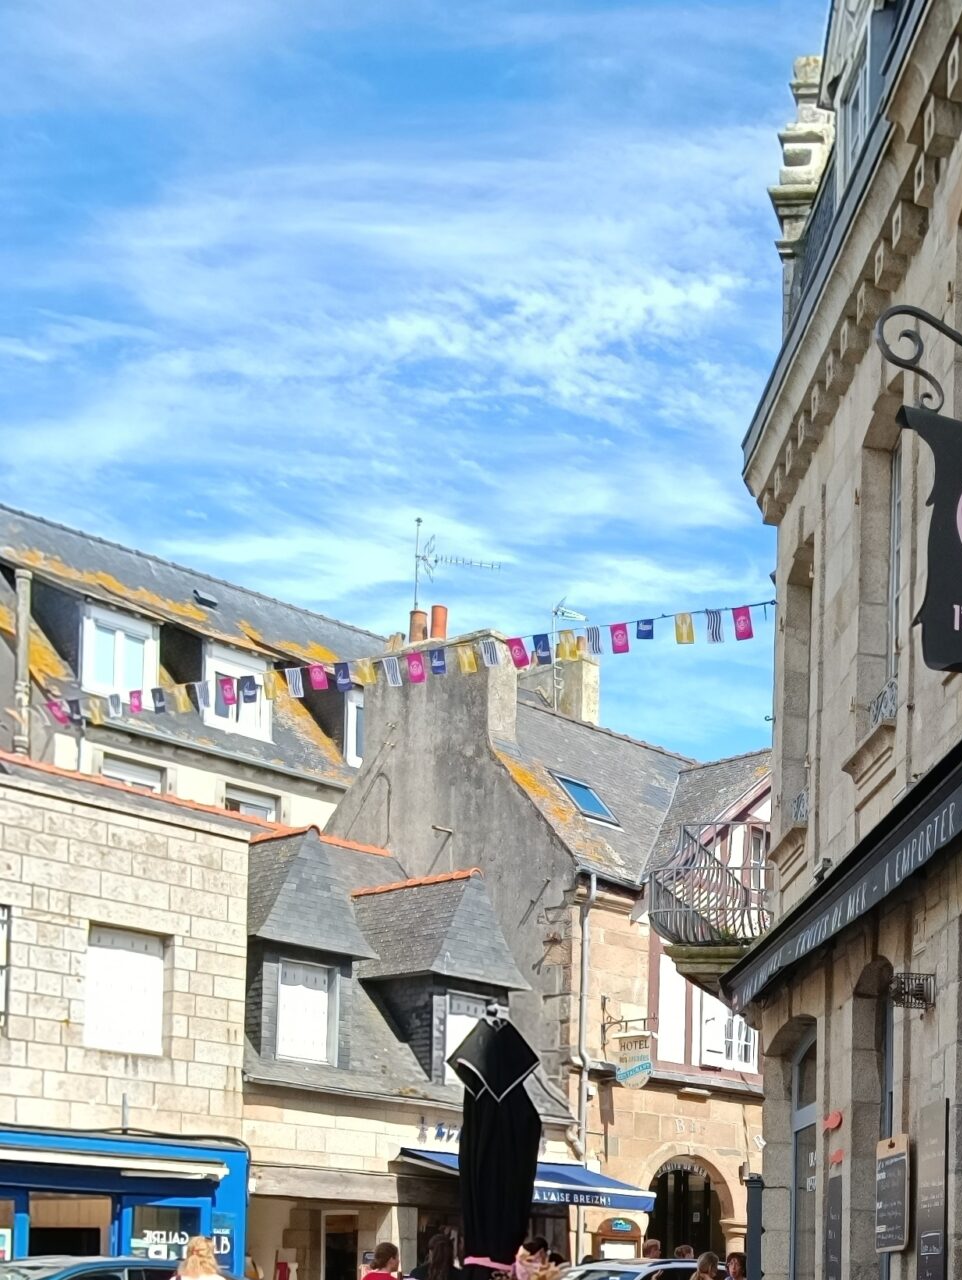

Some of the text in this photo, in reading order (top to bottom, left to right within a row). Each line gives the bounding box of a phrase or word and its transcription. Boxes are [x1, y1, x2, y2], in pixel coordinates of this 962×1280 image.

[847, 882, 867, 921] MER
[895, 802, 956, 883] EMPORTER
[619, 1039, 650, 1052] HOTEL
